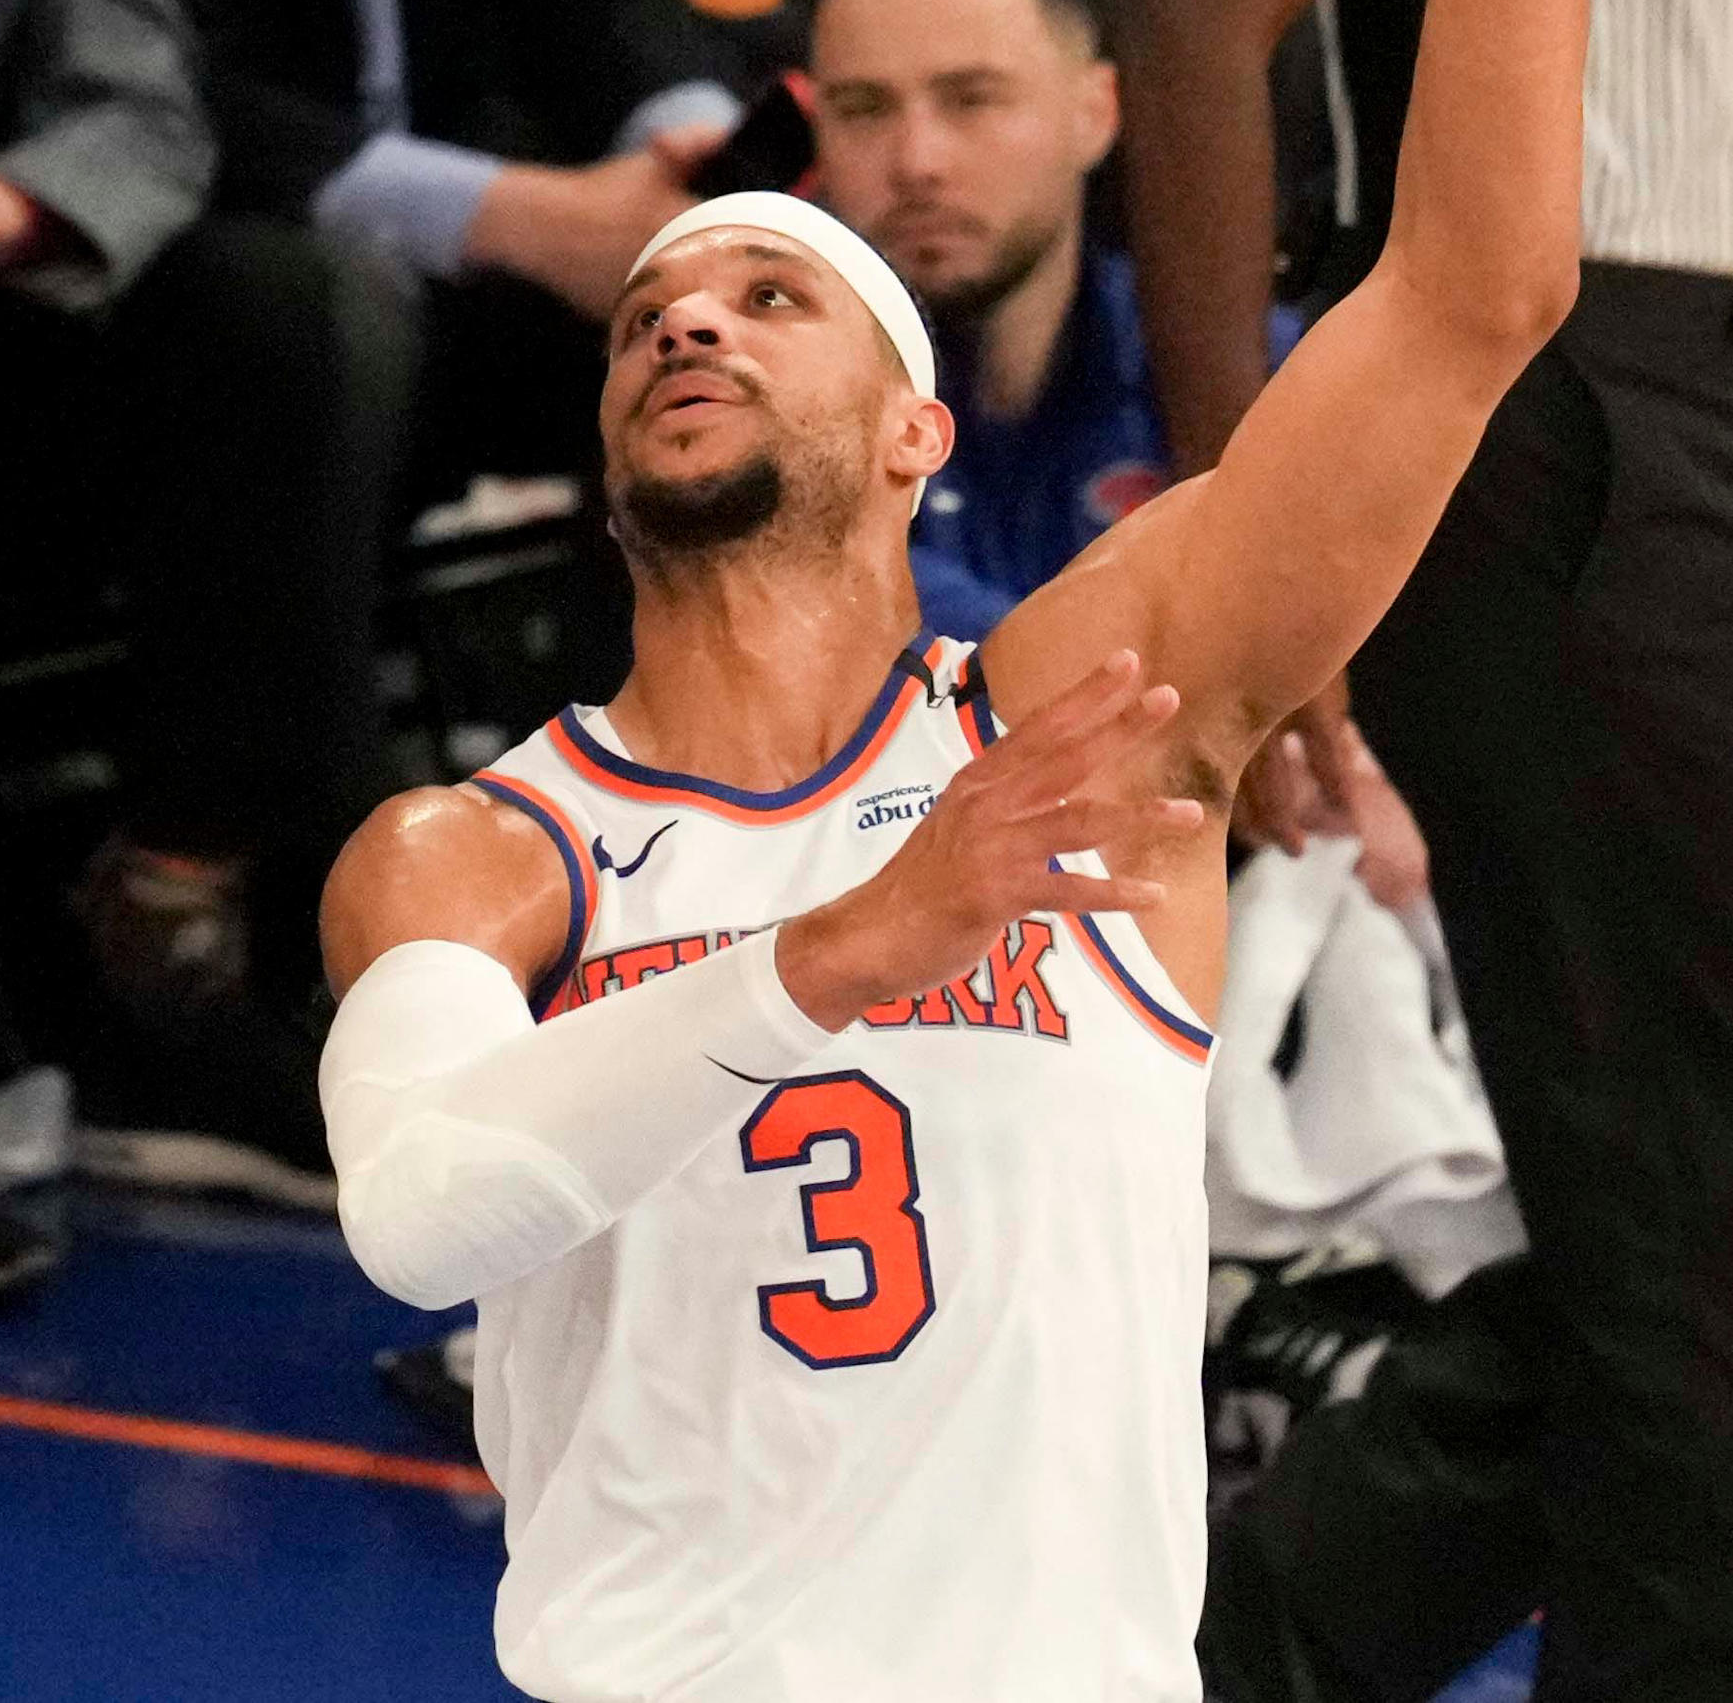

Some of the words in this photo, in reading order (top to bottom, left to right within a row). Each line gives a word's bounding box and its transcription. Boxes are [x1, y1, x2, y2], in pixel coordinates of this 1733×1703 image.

[856, 784, 933, 807] experience
[858, 802, 913, 830] abu
[739, 1069, 936, 1371] 3
